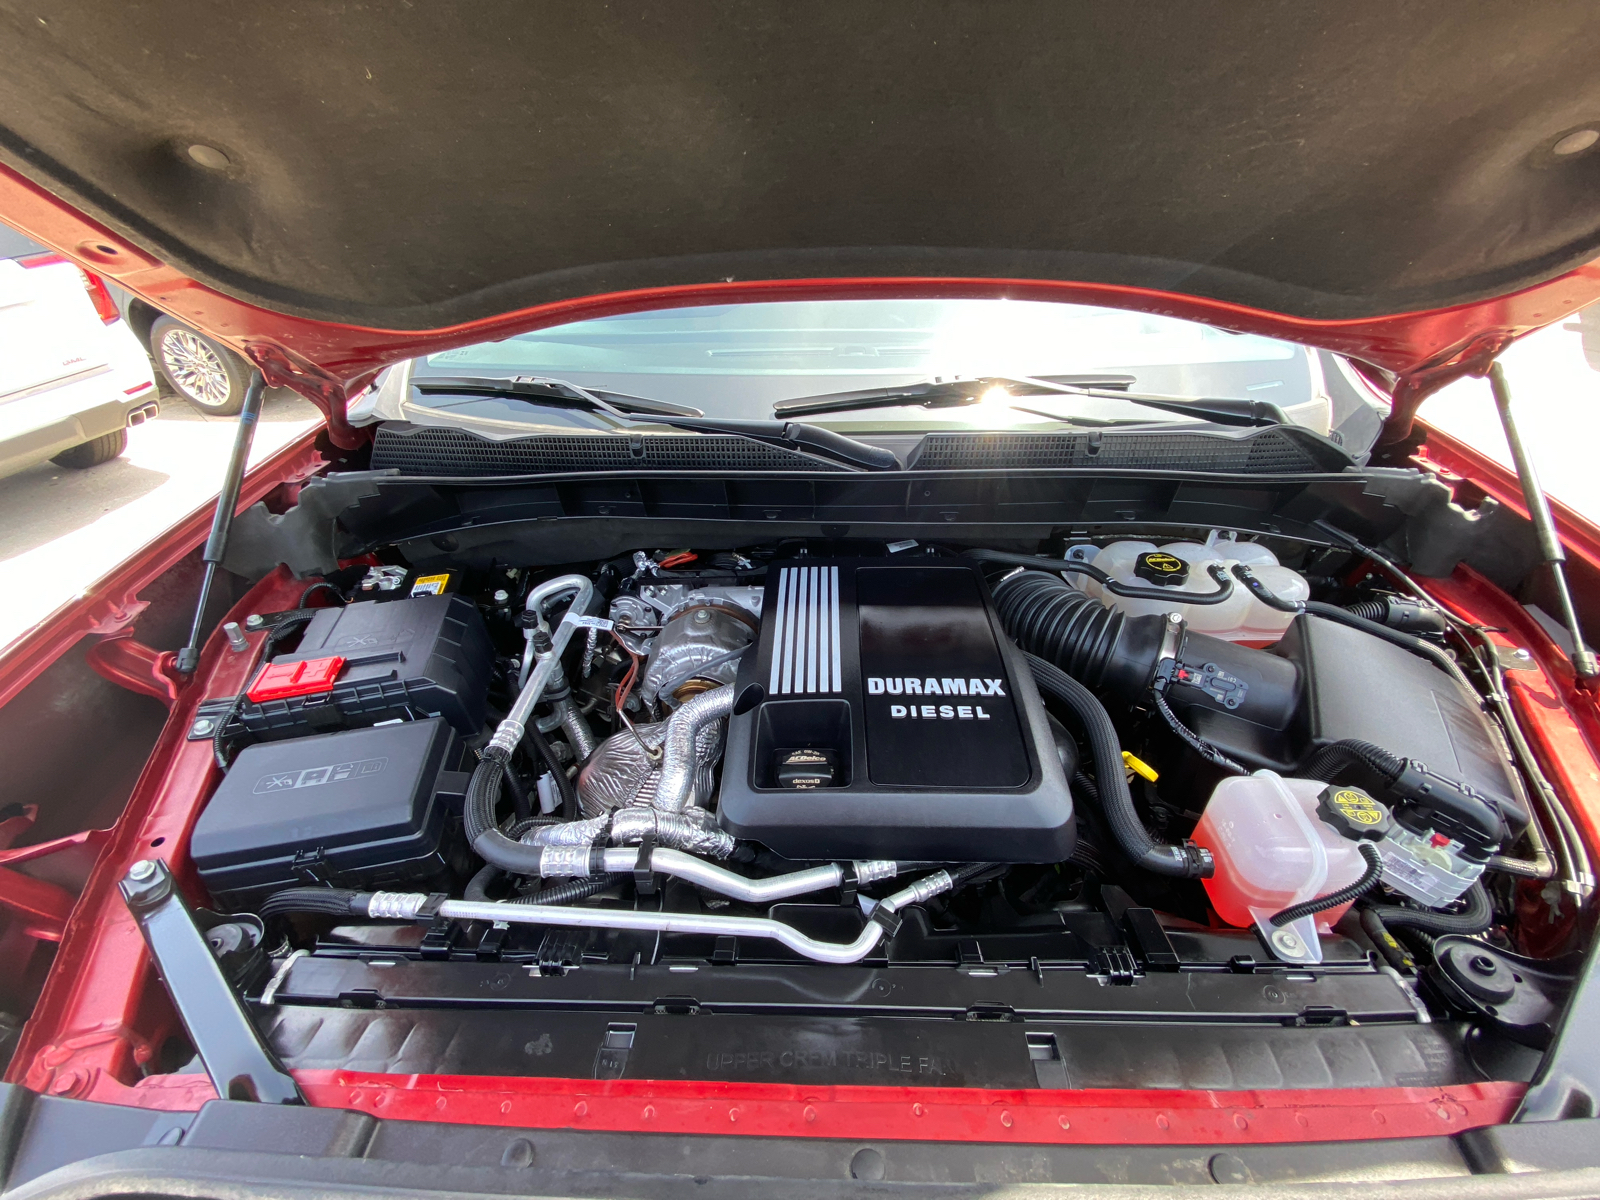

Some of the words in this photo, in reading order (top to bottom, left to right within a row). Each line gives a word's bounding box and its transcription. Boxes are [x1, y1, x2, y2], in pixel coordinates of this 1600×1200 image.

[867, 677, 1006, 697] DURAMAX
[890, 705, 991, 720] DIESEL
[785, 755, 827, 763] ACDelco
[706, 1051, 775, 1071] UPPER
[842, 1050, 913, 1073] TRIPLE
